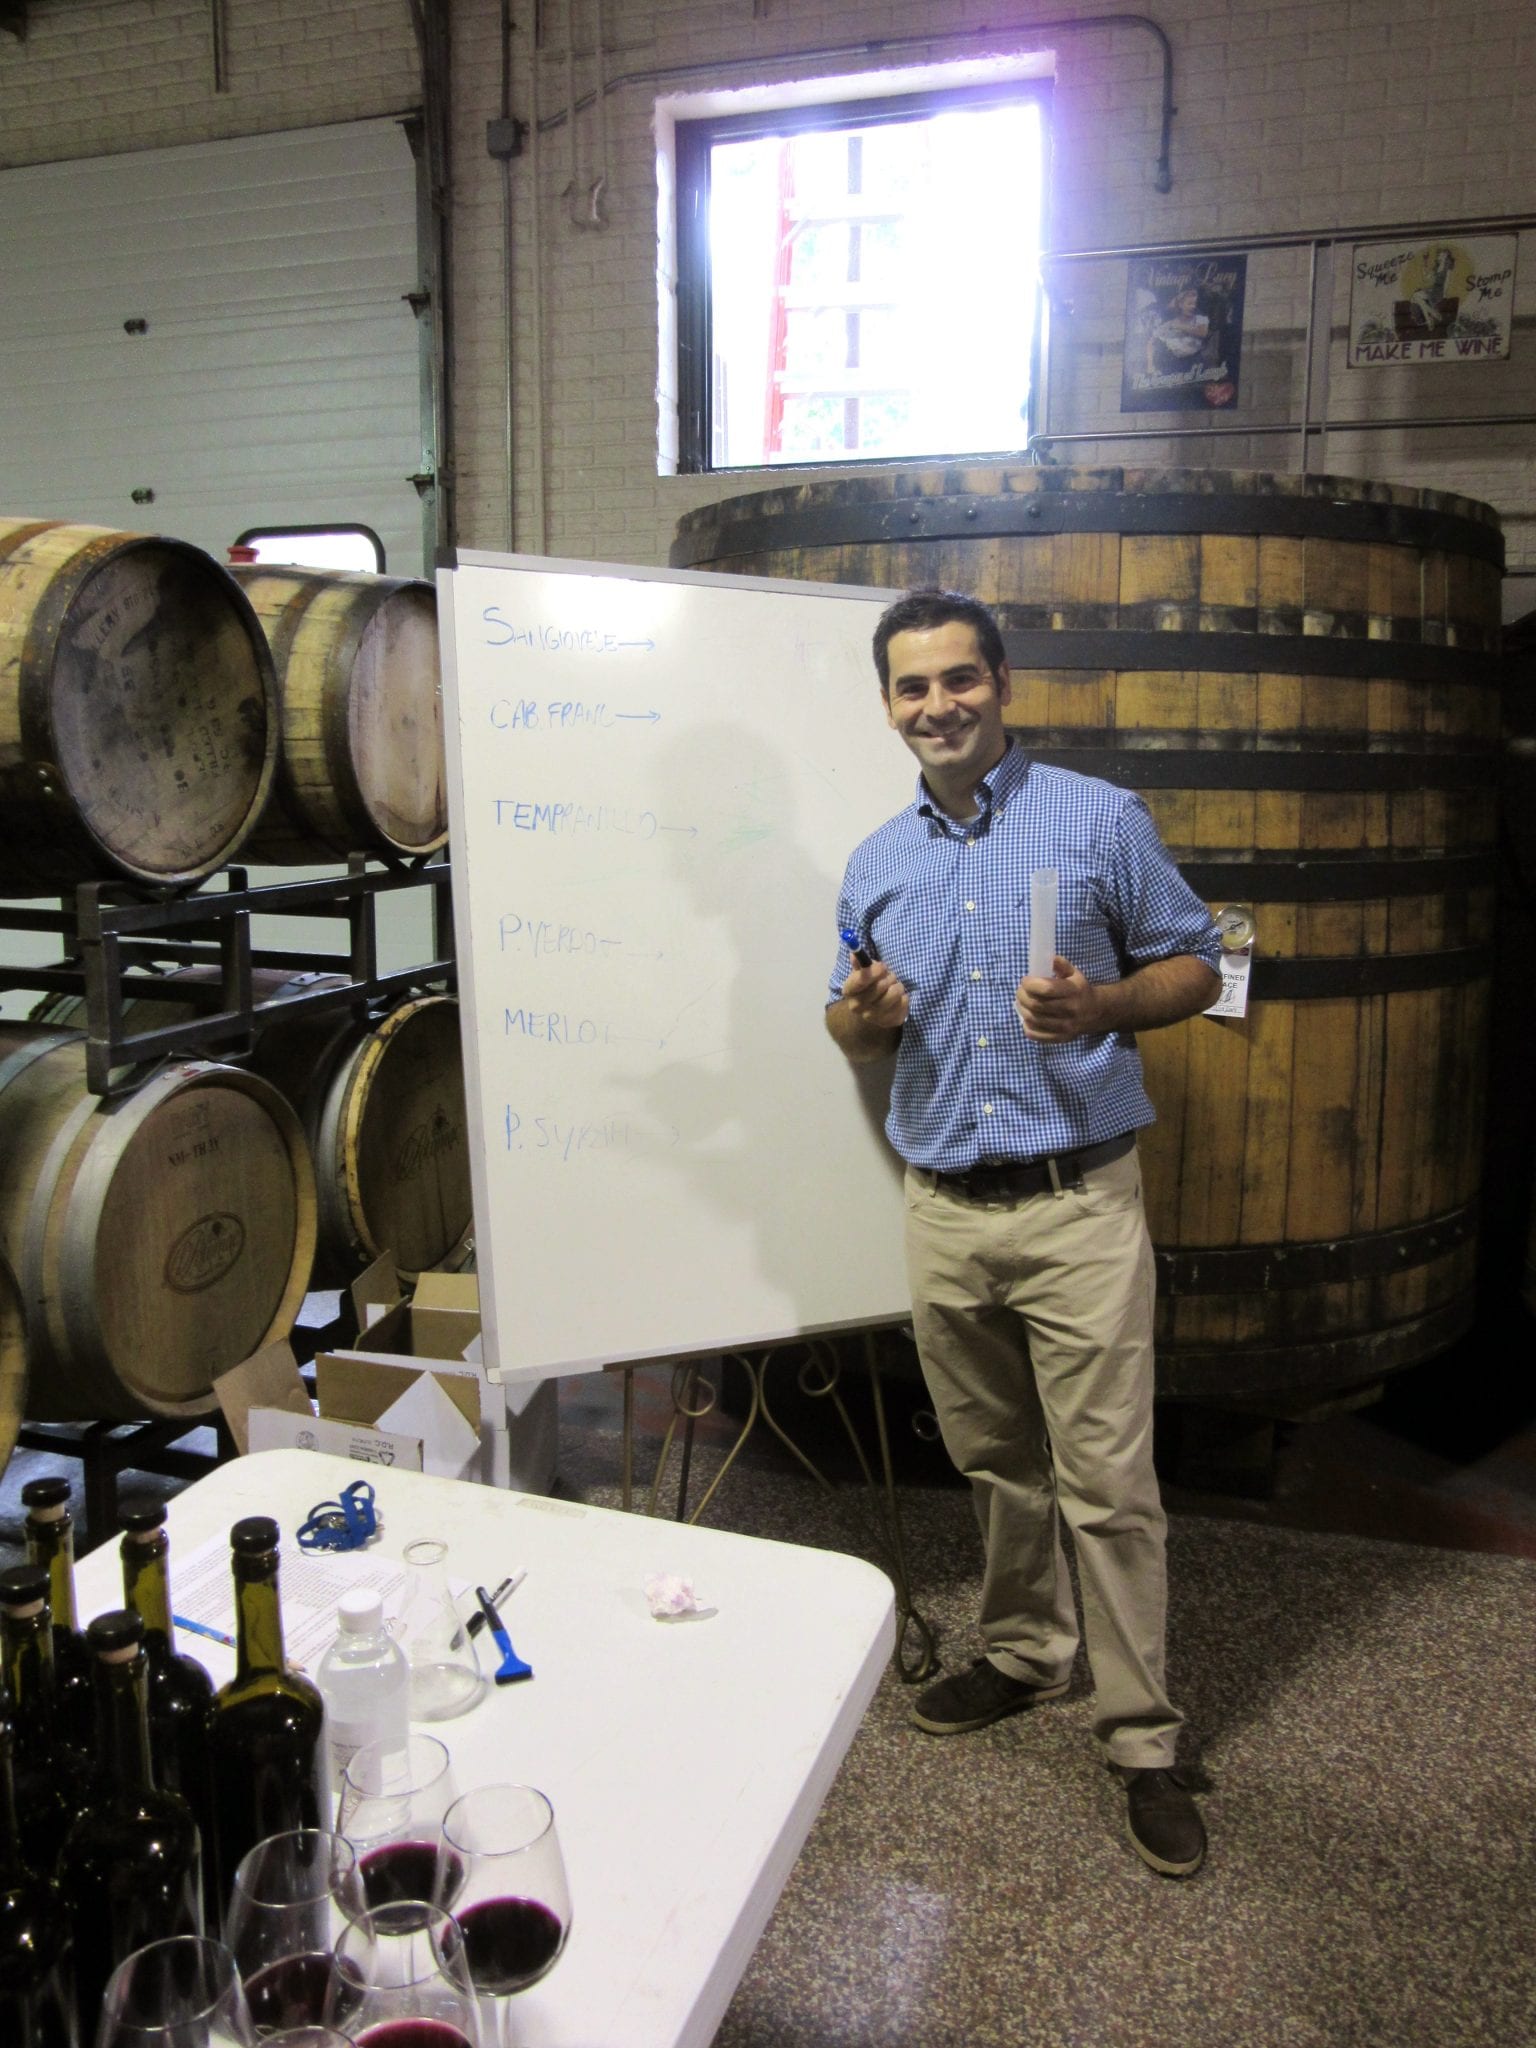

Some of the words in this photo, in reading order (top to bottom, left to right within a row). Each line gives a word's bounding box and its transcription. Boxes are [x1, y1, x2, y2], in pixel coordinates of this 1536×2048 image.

[1356, 251, 1415, 280] Squeeze
[1375, 272, 1399, 288] Me
[1465, 269, 1512, 292] Stomp
[1479, 287, 1503, 303] Me
[1355, 342, 1412, 362] MAKE
[1419, 340, 1446, 358] ME
[1455, 337, 1503, 356] WINE
[1223, 973, 1245, 982] FINED
[1222, 982, 1238, 990] ACE
